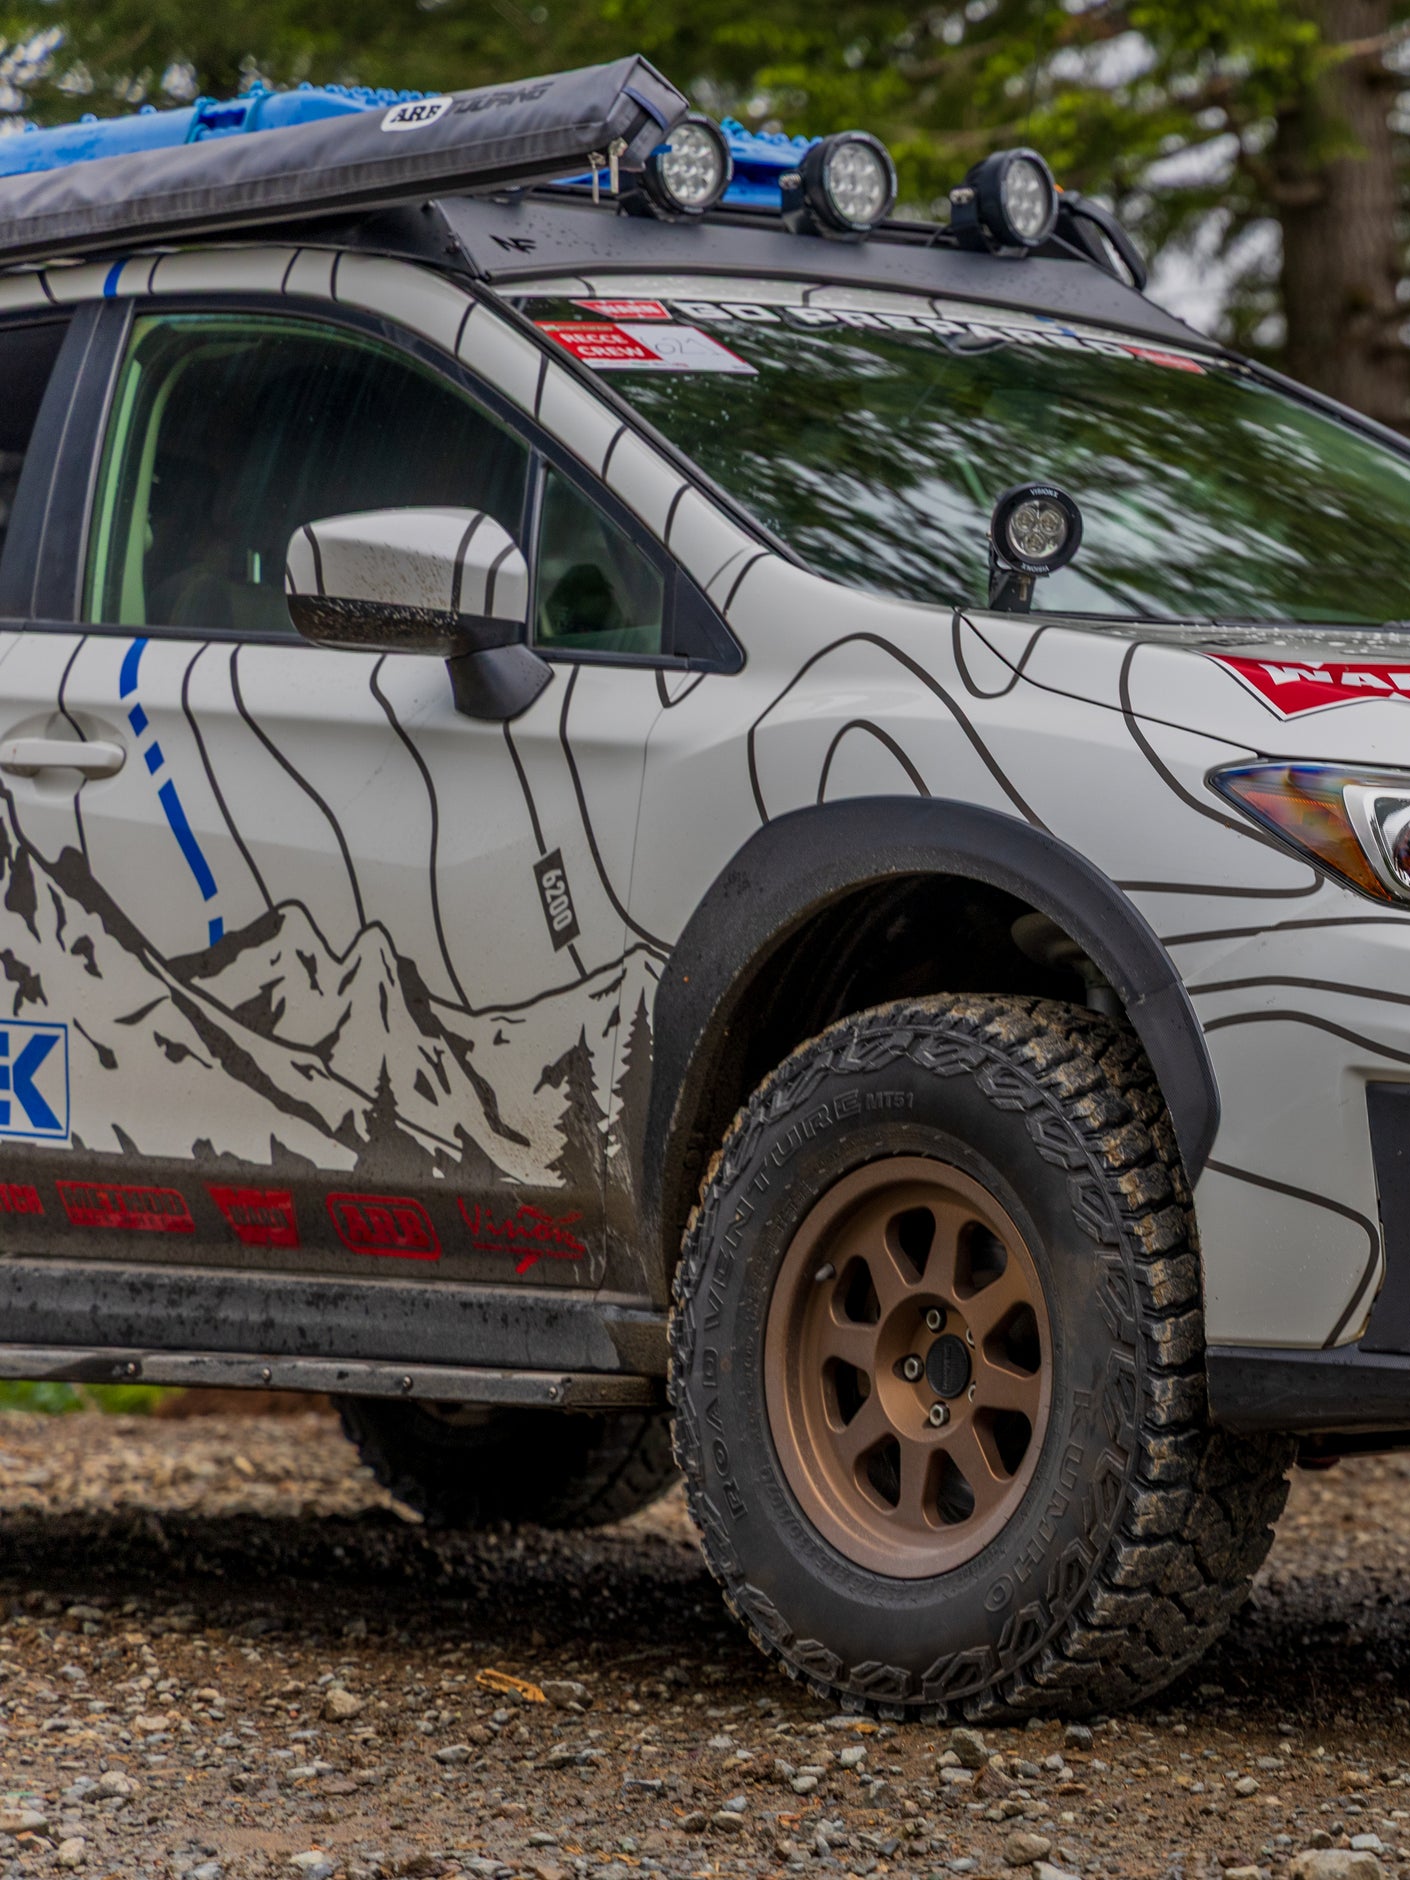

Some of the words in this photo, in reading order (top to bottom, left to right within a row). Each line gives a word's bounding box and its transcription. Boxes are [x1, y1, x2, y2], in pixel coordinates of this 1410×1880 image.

[559, 333, 629, 345] RECCE
[577, 346, 646, 358] CREW
[671, 300, 782, 323] GO
[785, 306, 1136, 360] PREPARED
[541, 868, 574, 933] 6200
[0, 1031, 64, 1131] K
[61, 1186, 187, 1217] METHOD
[228, 1204, 290, 1229] WARN
[340, 1203, 432, 1249] ARB
[702, 1346, 749, 1521] ROAD
[865, 1091, 915, 1112] MT51
[983, 1388, 1093, 1613] KUMHO
